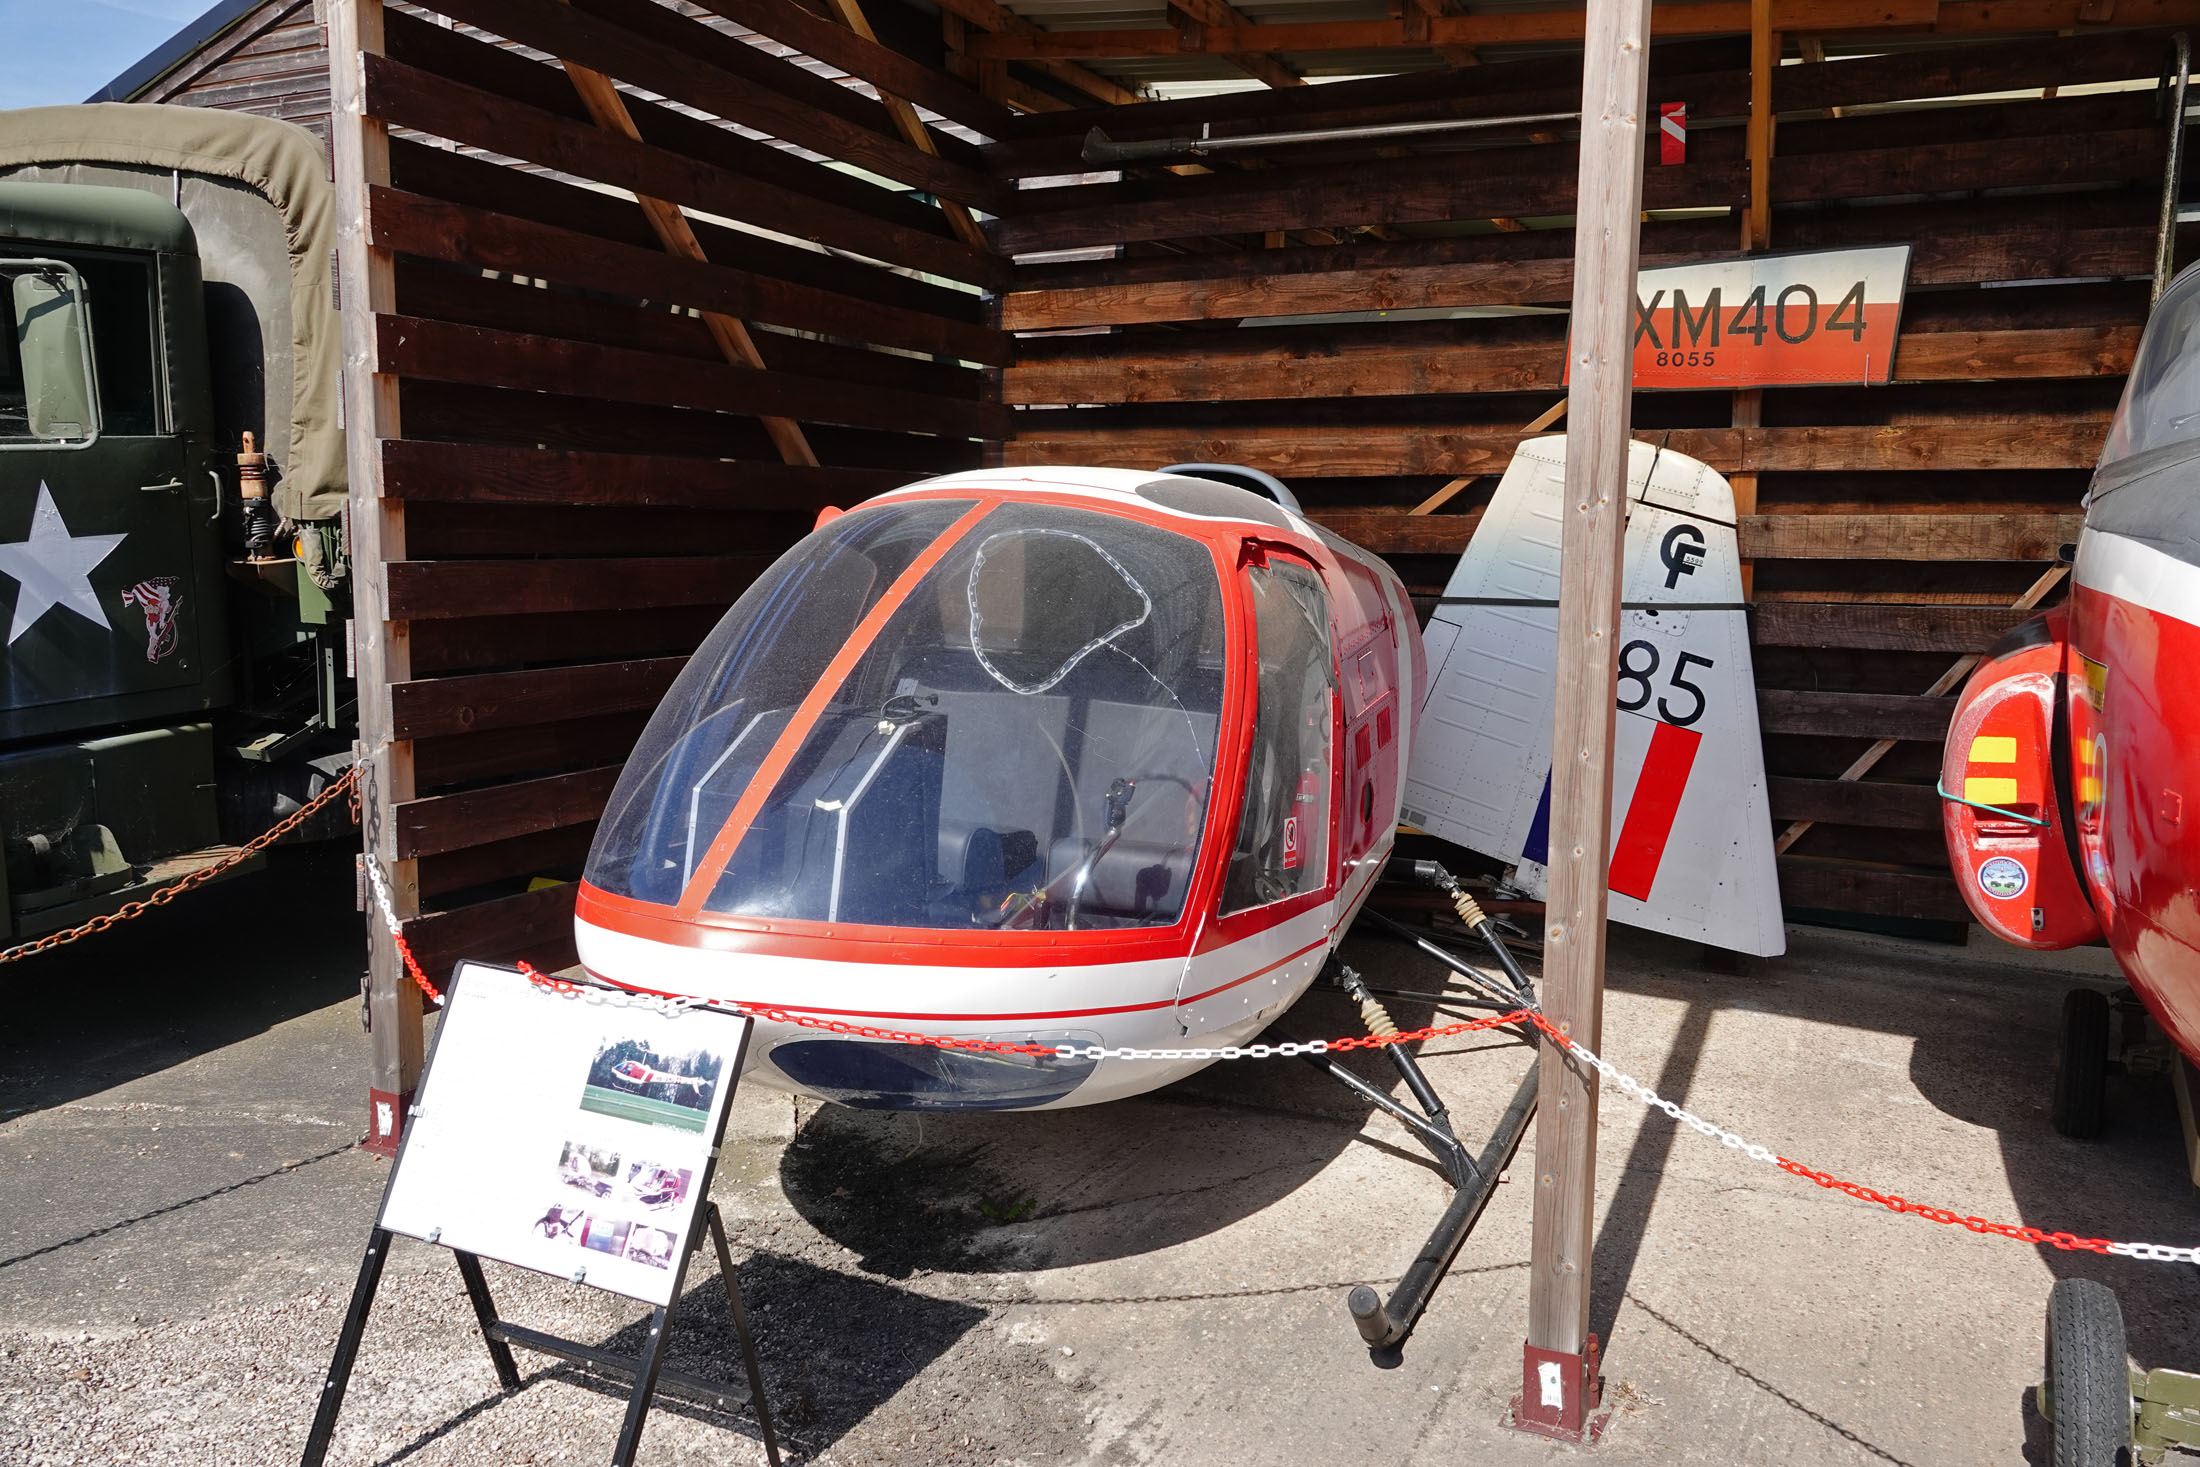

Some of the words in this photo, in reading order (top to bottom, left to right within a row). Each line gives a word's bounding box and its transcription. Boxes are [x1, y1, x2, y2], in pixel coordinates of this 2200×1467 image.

[1634, 281, 1867, 349] XM404
[1656, 351, 1715, 367] 8055
[1616, 640, 1714, 726] 85
